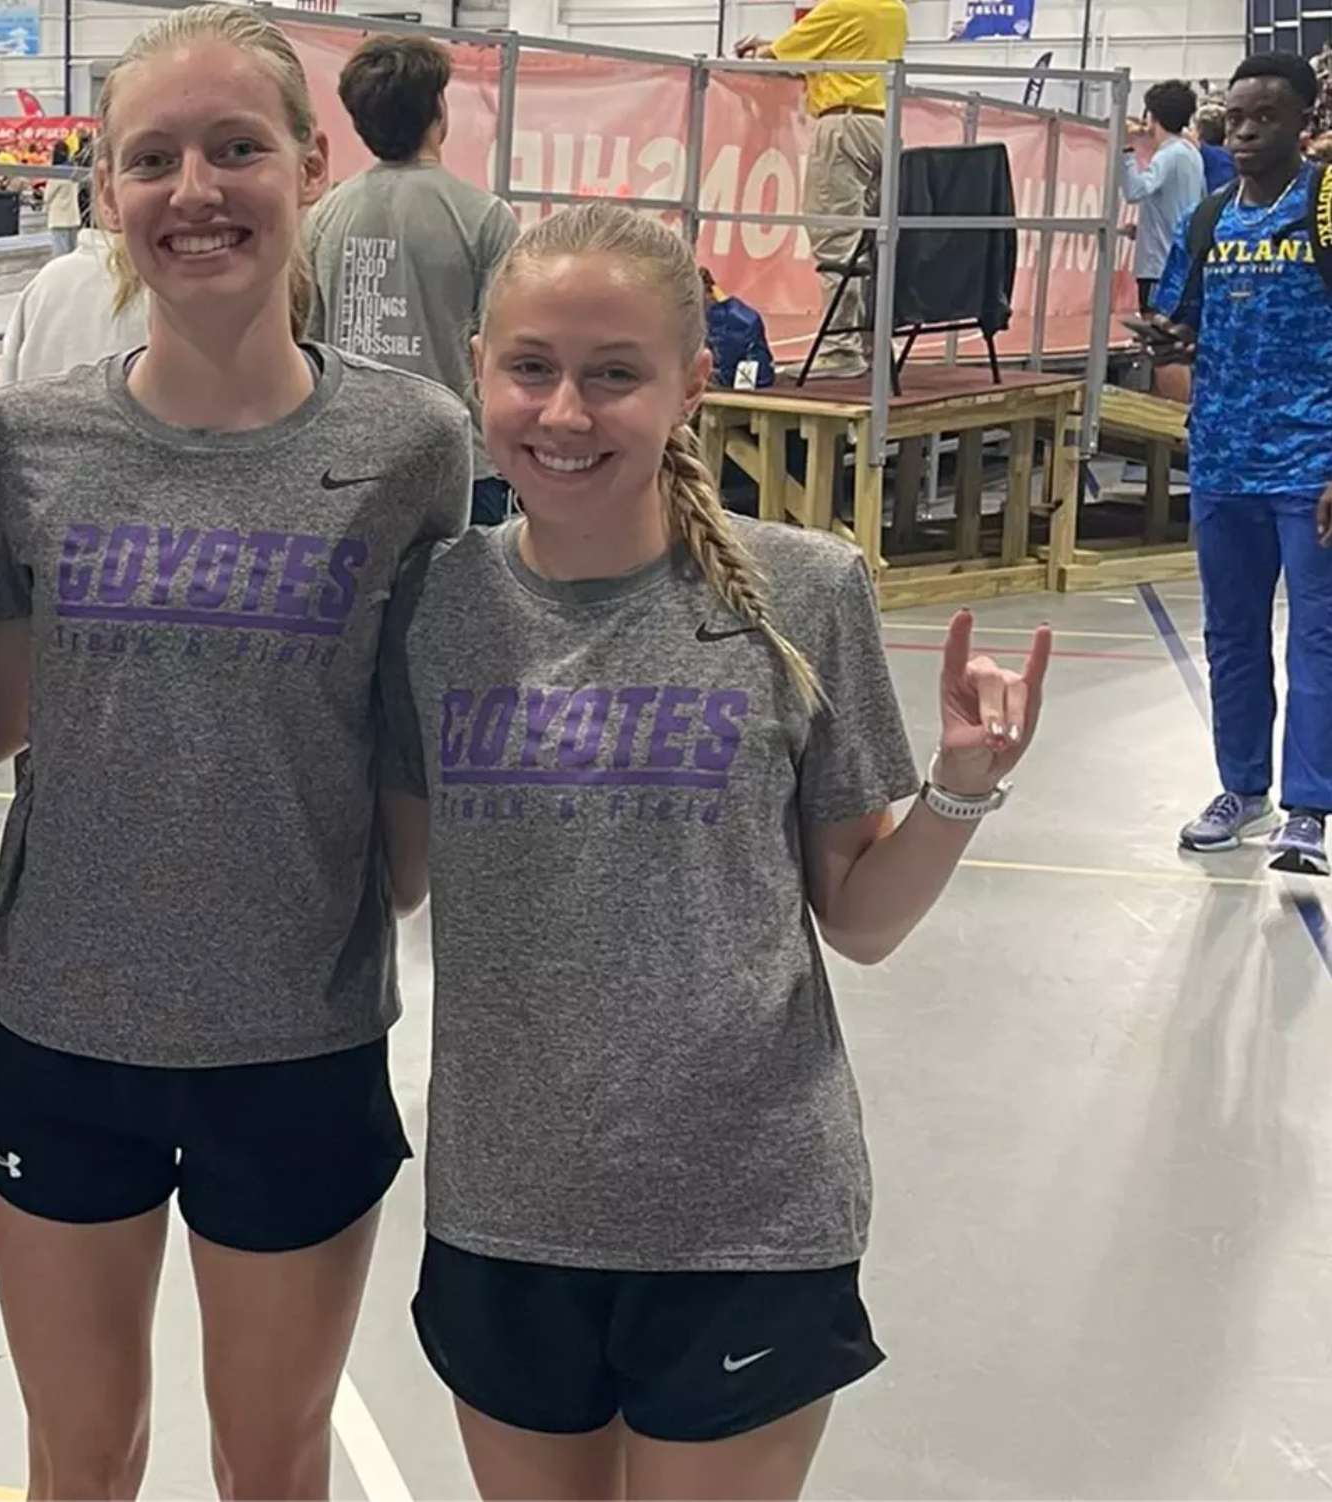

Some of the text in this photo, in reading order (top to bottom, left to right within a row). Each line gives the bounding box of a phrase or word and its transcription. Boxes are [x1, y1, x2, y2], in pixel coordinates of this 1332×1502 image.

[357, 238, 396, 259] WITH
[356, 257, 387, 278] GOD
[356, 277, 381, 299] ALL
[356, 296, 407, 317] THINGS
[354, 315, 382, 337] ARE
[353, 334, 422, 355] POSSIBLE
[57, 523, 368, 619] COYOTES
[440, 684, 749, 771] COYOTES
